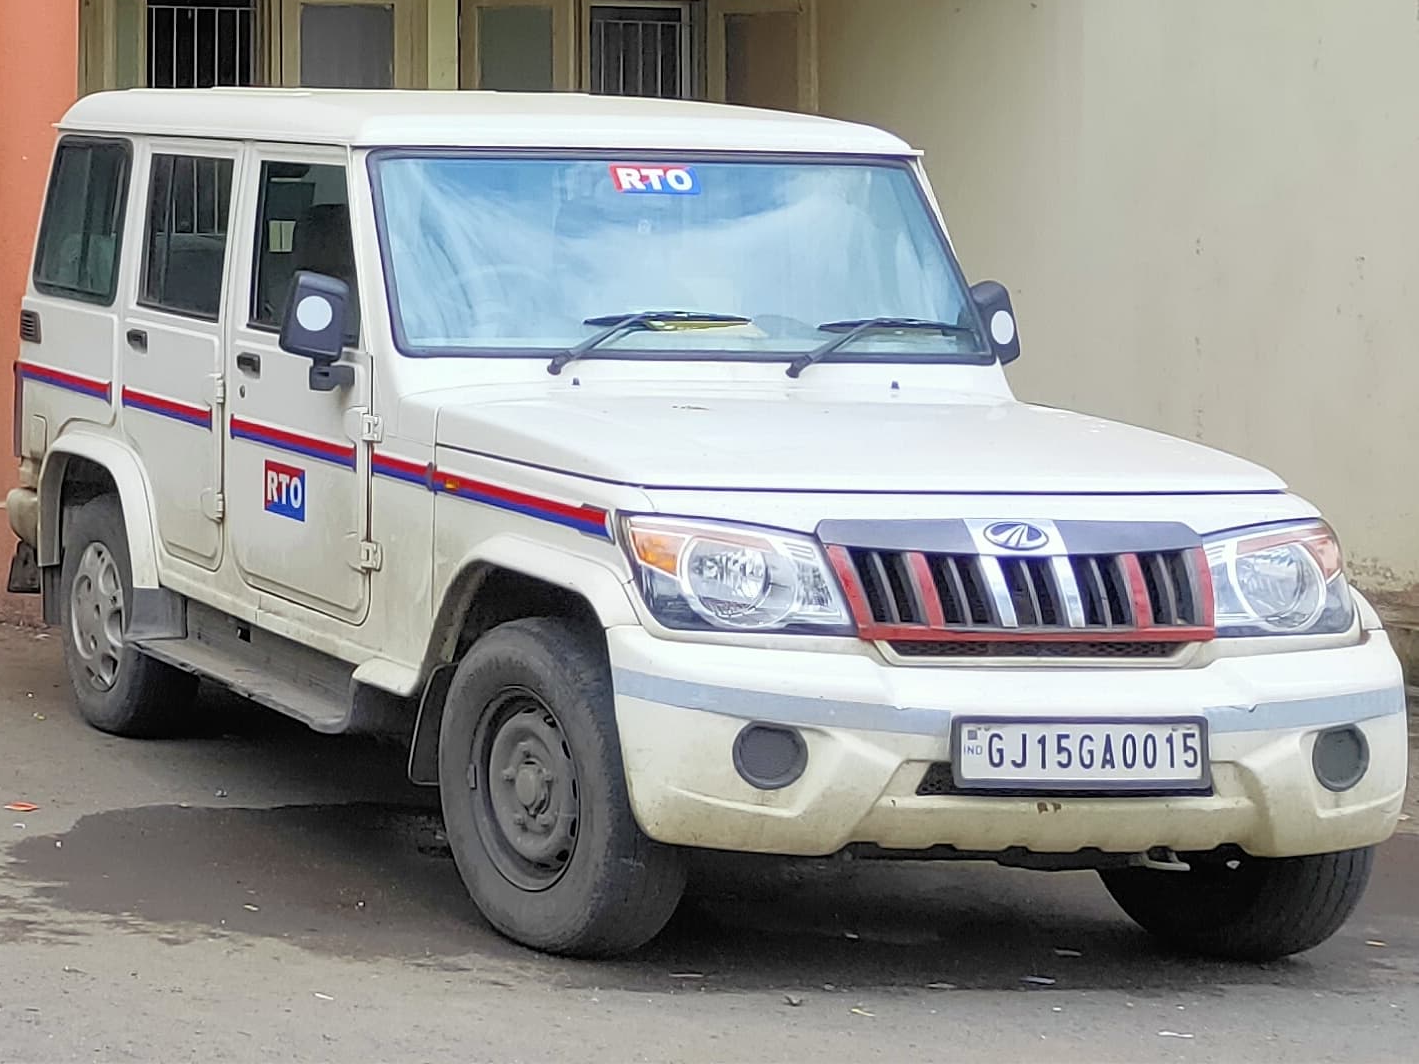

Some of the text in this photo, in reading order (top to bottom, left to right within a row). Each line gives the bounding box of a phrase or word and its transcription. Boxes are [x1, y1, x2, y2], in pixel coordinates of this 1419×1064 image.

[616, 167, 693, 191] RTO
[267, 469, 302, 509] RTO
[963, 744, 983, 756] IND
[987, 732, 1199, 770] GJ15GA0015
